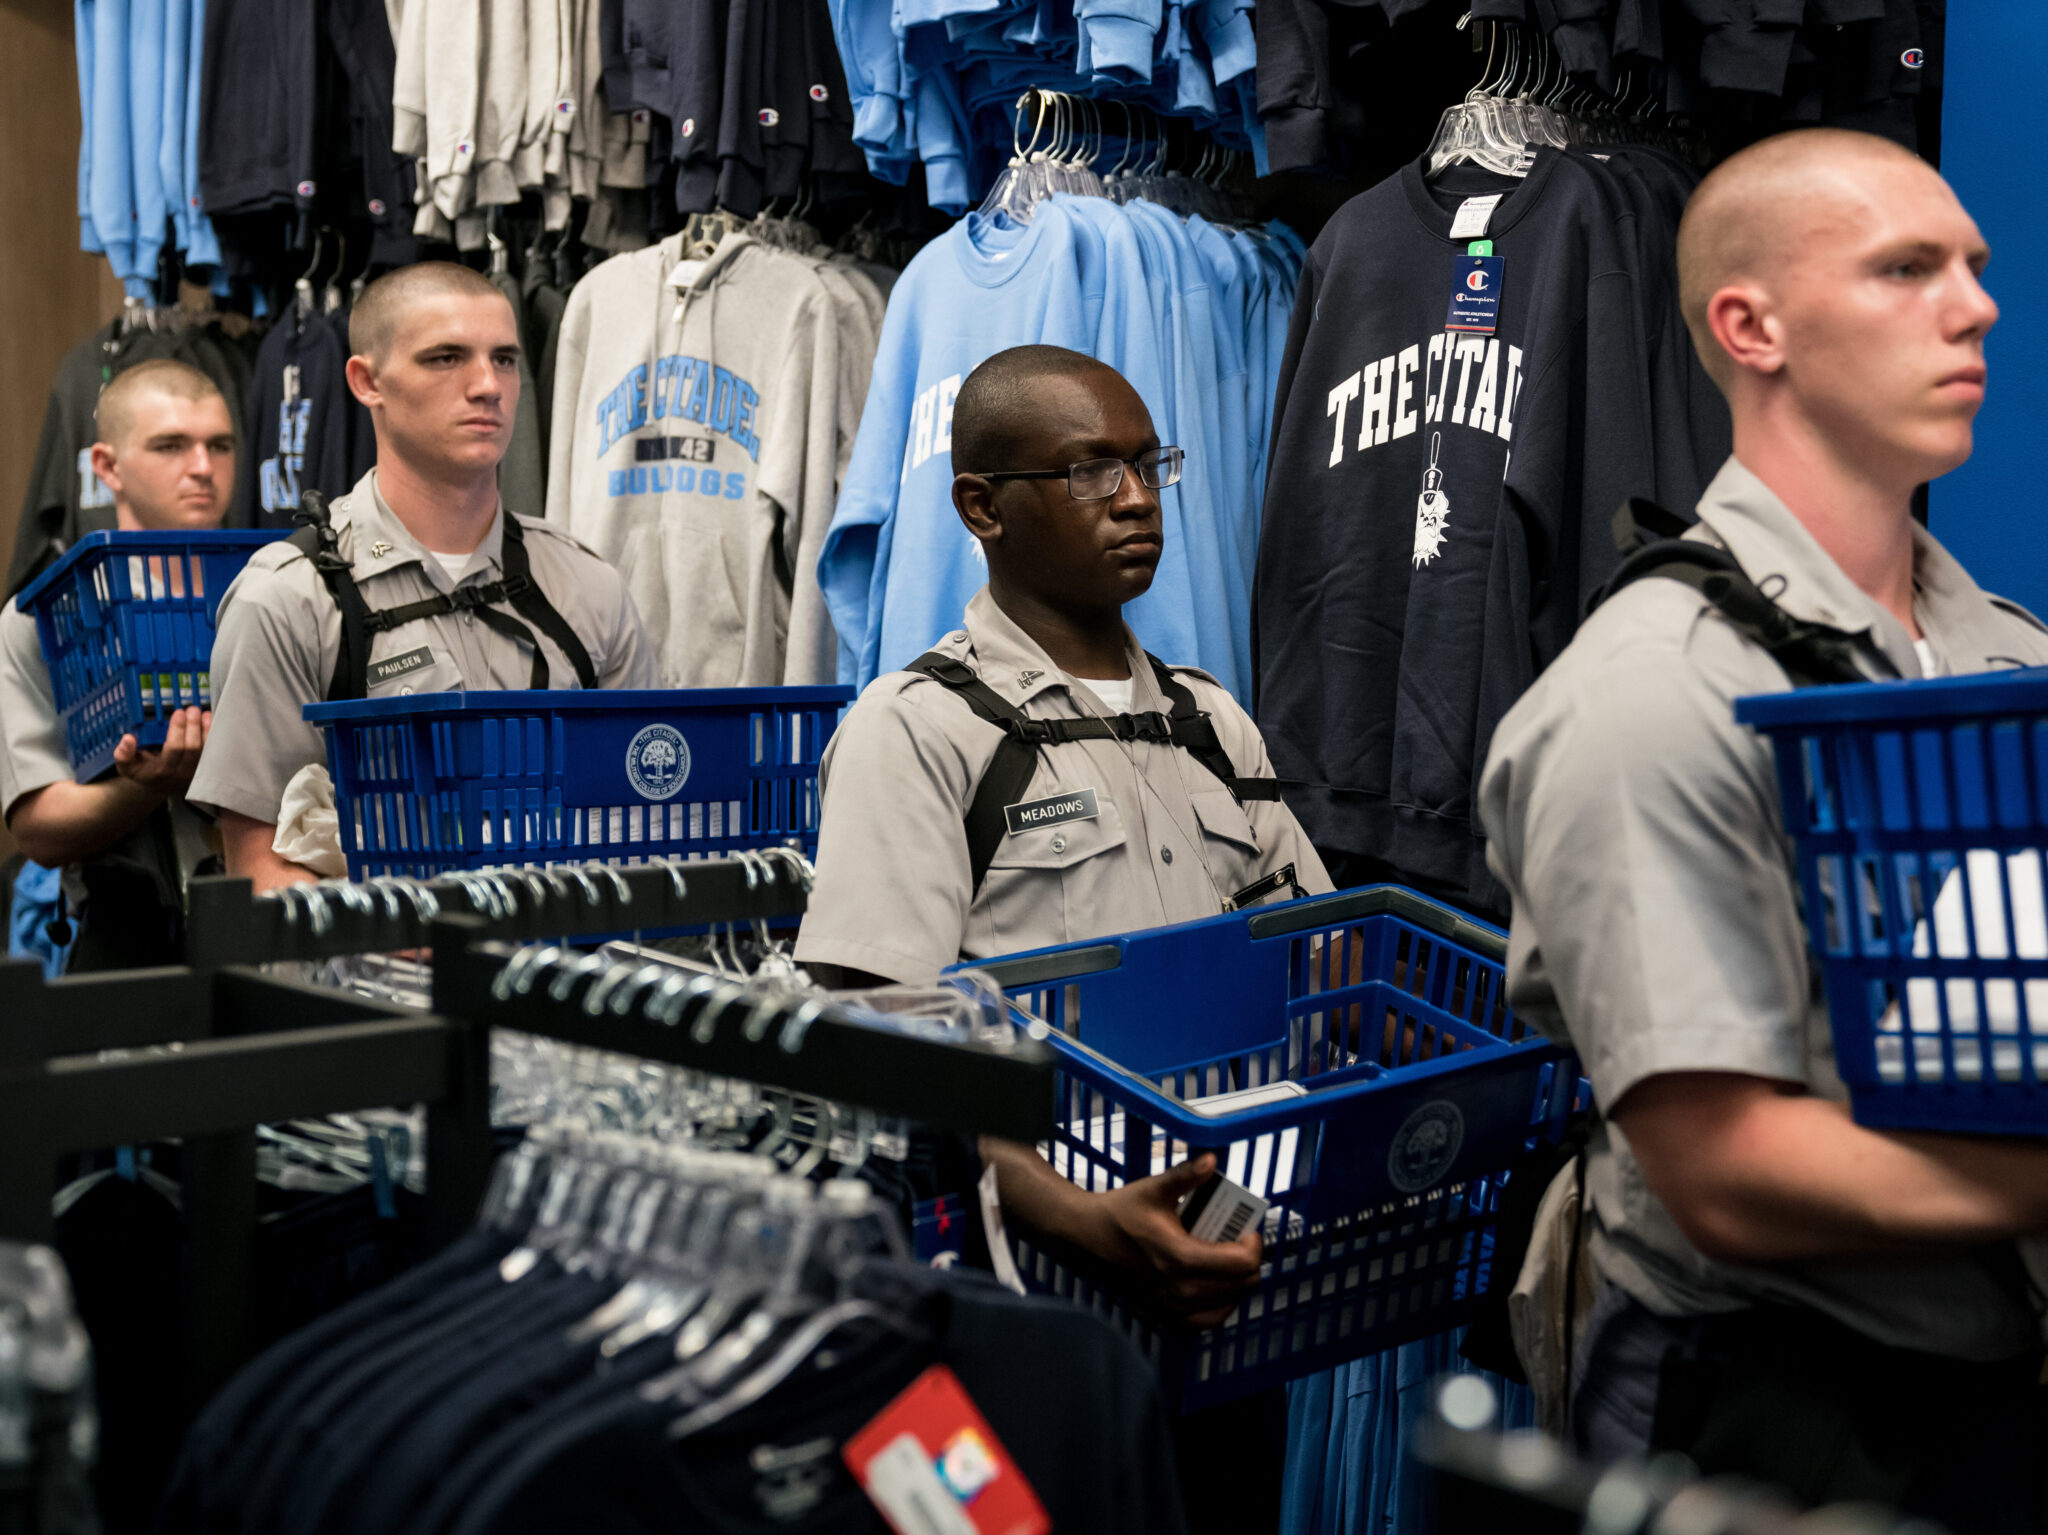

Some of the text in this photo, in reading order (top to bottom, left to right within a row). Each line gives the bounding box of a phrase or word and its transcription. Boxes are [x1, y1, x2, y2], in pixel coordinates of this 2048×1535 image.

[1456, 293, 1495, 305] Champion
[597, 354, 760, 464] THE CTADEL
[1327, 332, 1523, 469] THE CITAD
[679, 437, 709, 461] 42
[377, 654, 422, 678] PAULSEN
[653, 729, 677, 743] CITADEL
[1020, 799, 1084, 823] MEADOWS
